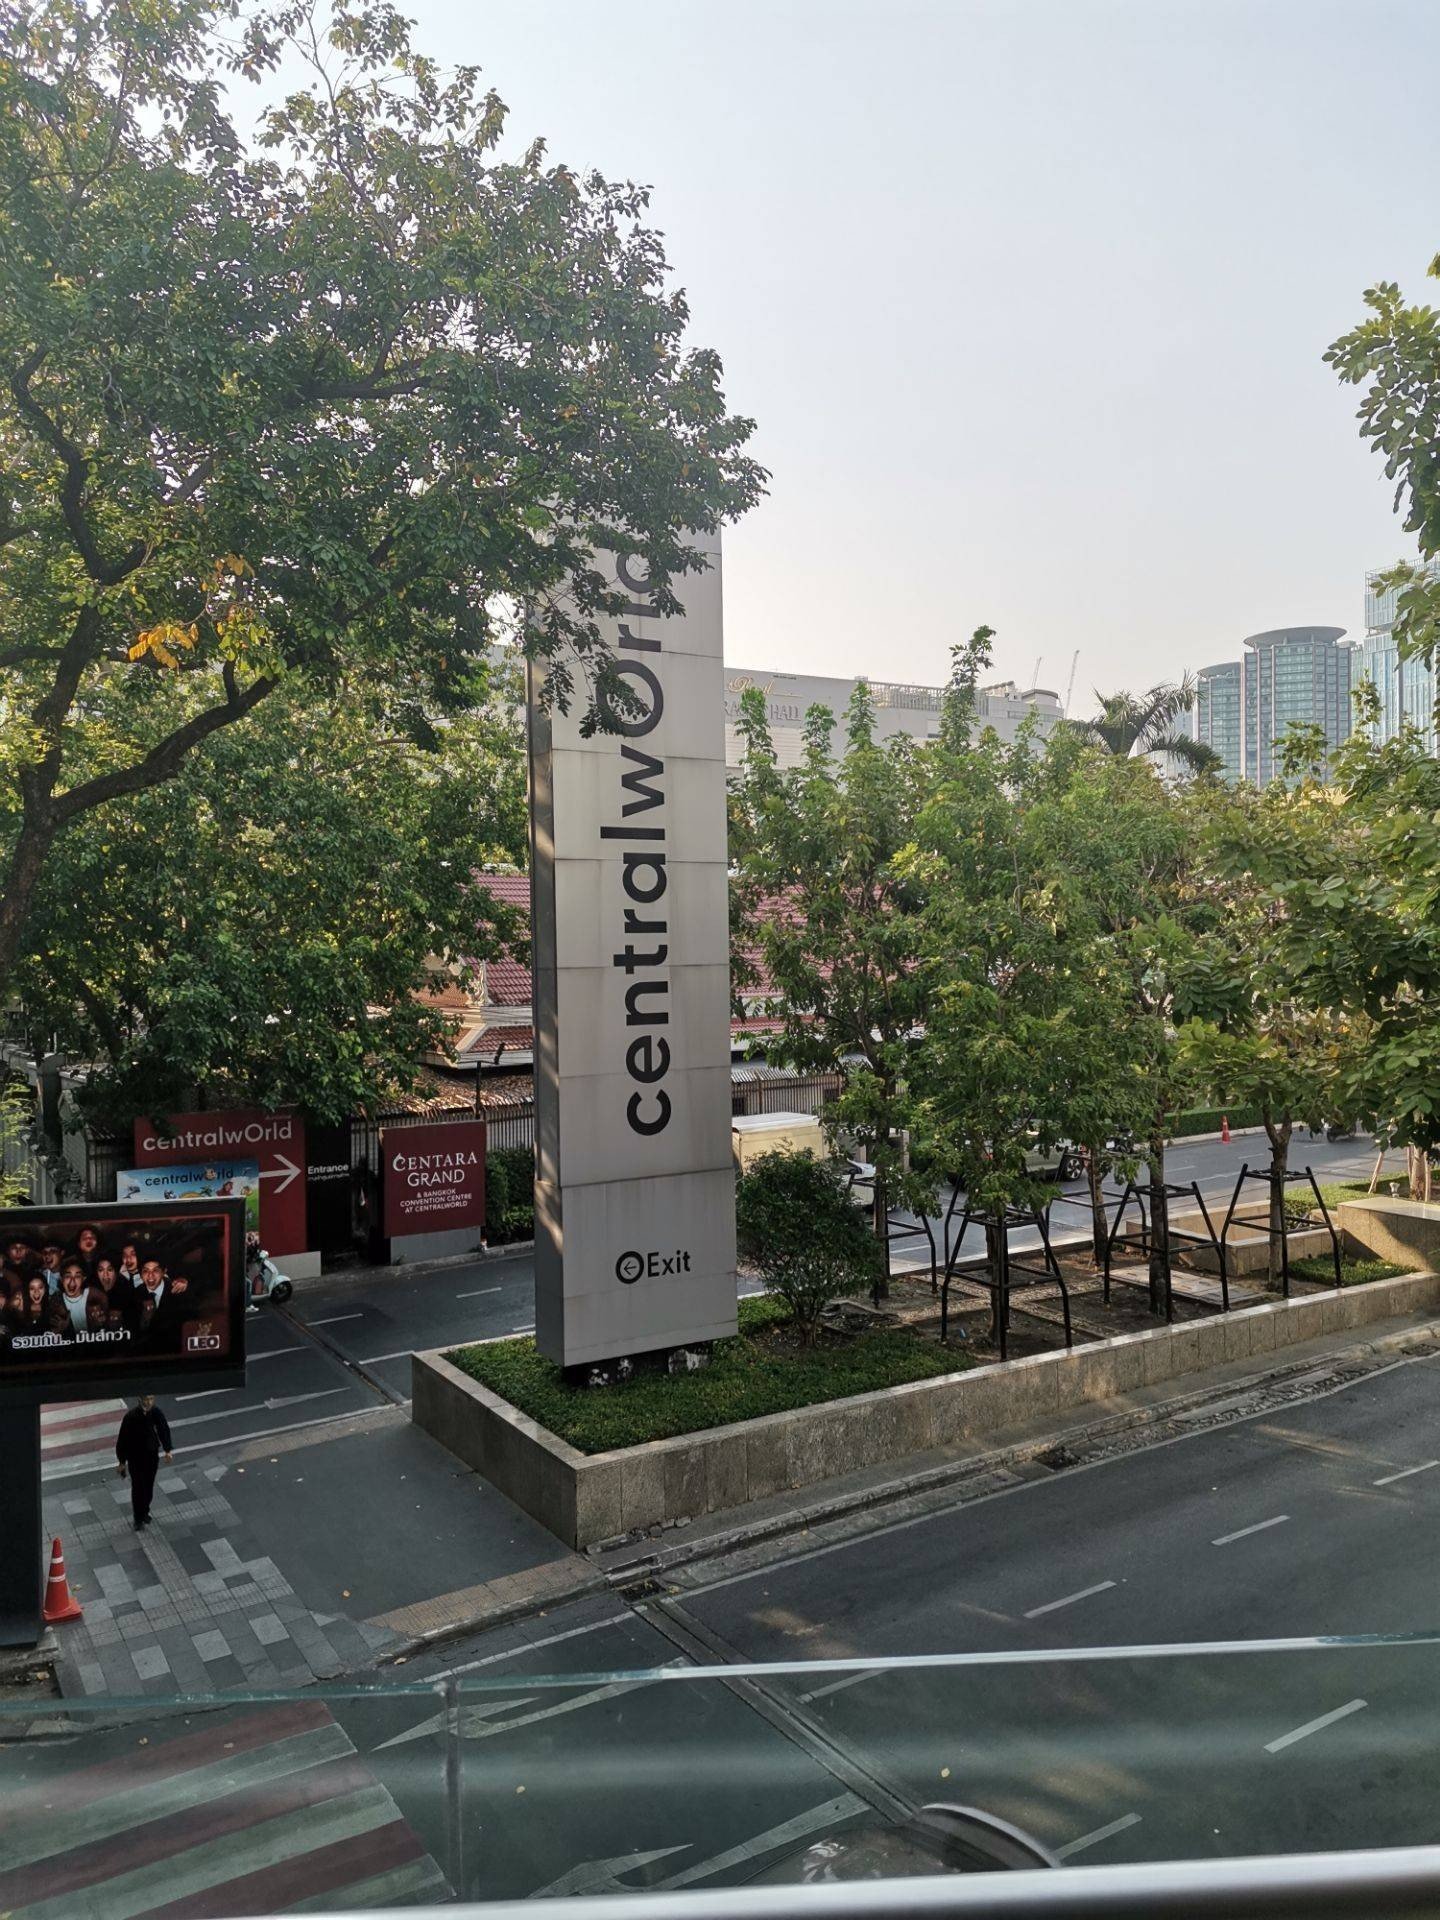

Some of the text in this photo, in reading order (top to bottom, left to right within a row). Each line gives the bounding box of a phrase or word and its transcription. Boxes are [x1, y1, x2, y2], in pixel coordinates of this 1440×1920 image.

[770, 703, 802, 721] HALL
[143, 1121, 292, 1151] centralwOrld
[307, 1164, 349, 1175] Entrance
[392, 1151, 478, 1172] CENTARA
[407, 1168, 465, 1187] GRAND
[400, 1193, 473, 1207] CONVENTION CENTRE
[423, 1188, 456, 1198] BANGKOK
[404, 1200, 468, 1213] AT CENTRALWORLD
[647, 1249, 691, 1278] Exit
[189, 1336, 219, 1350] LEO
